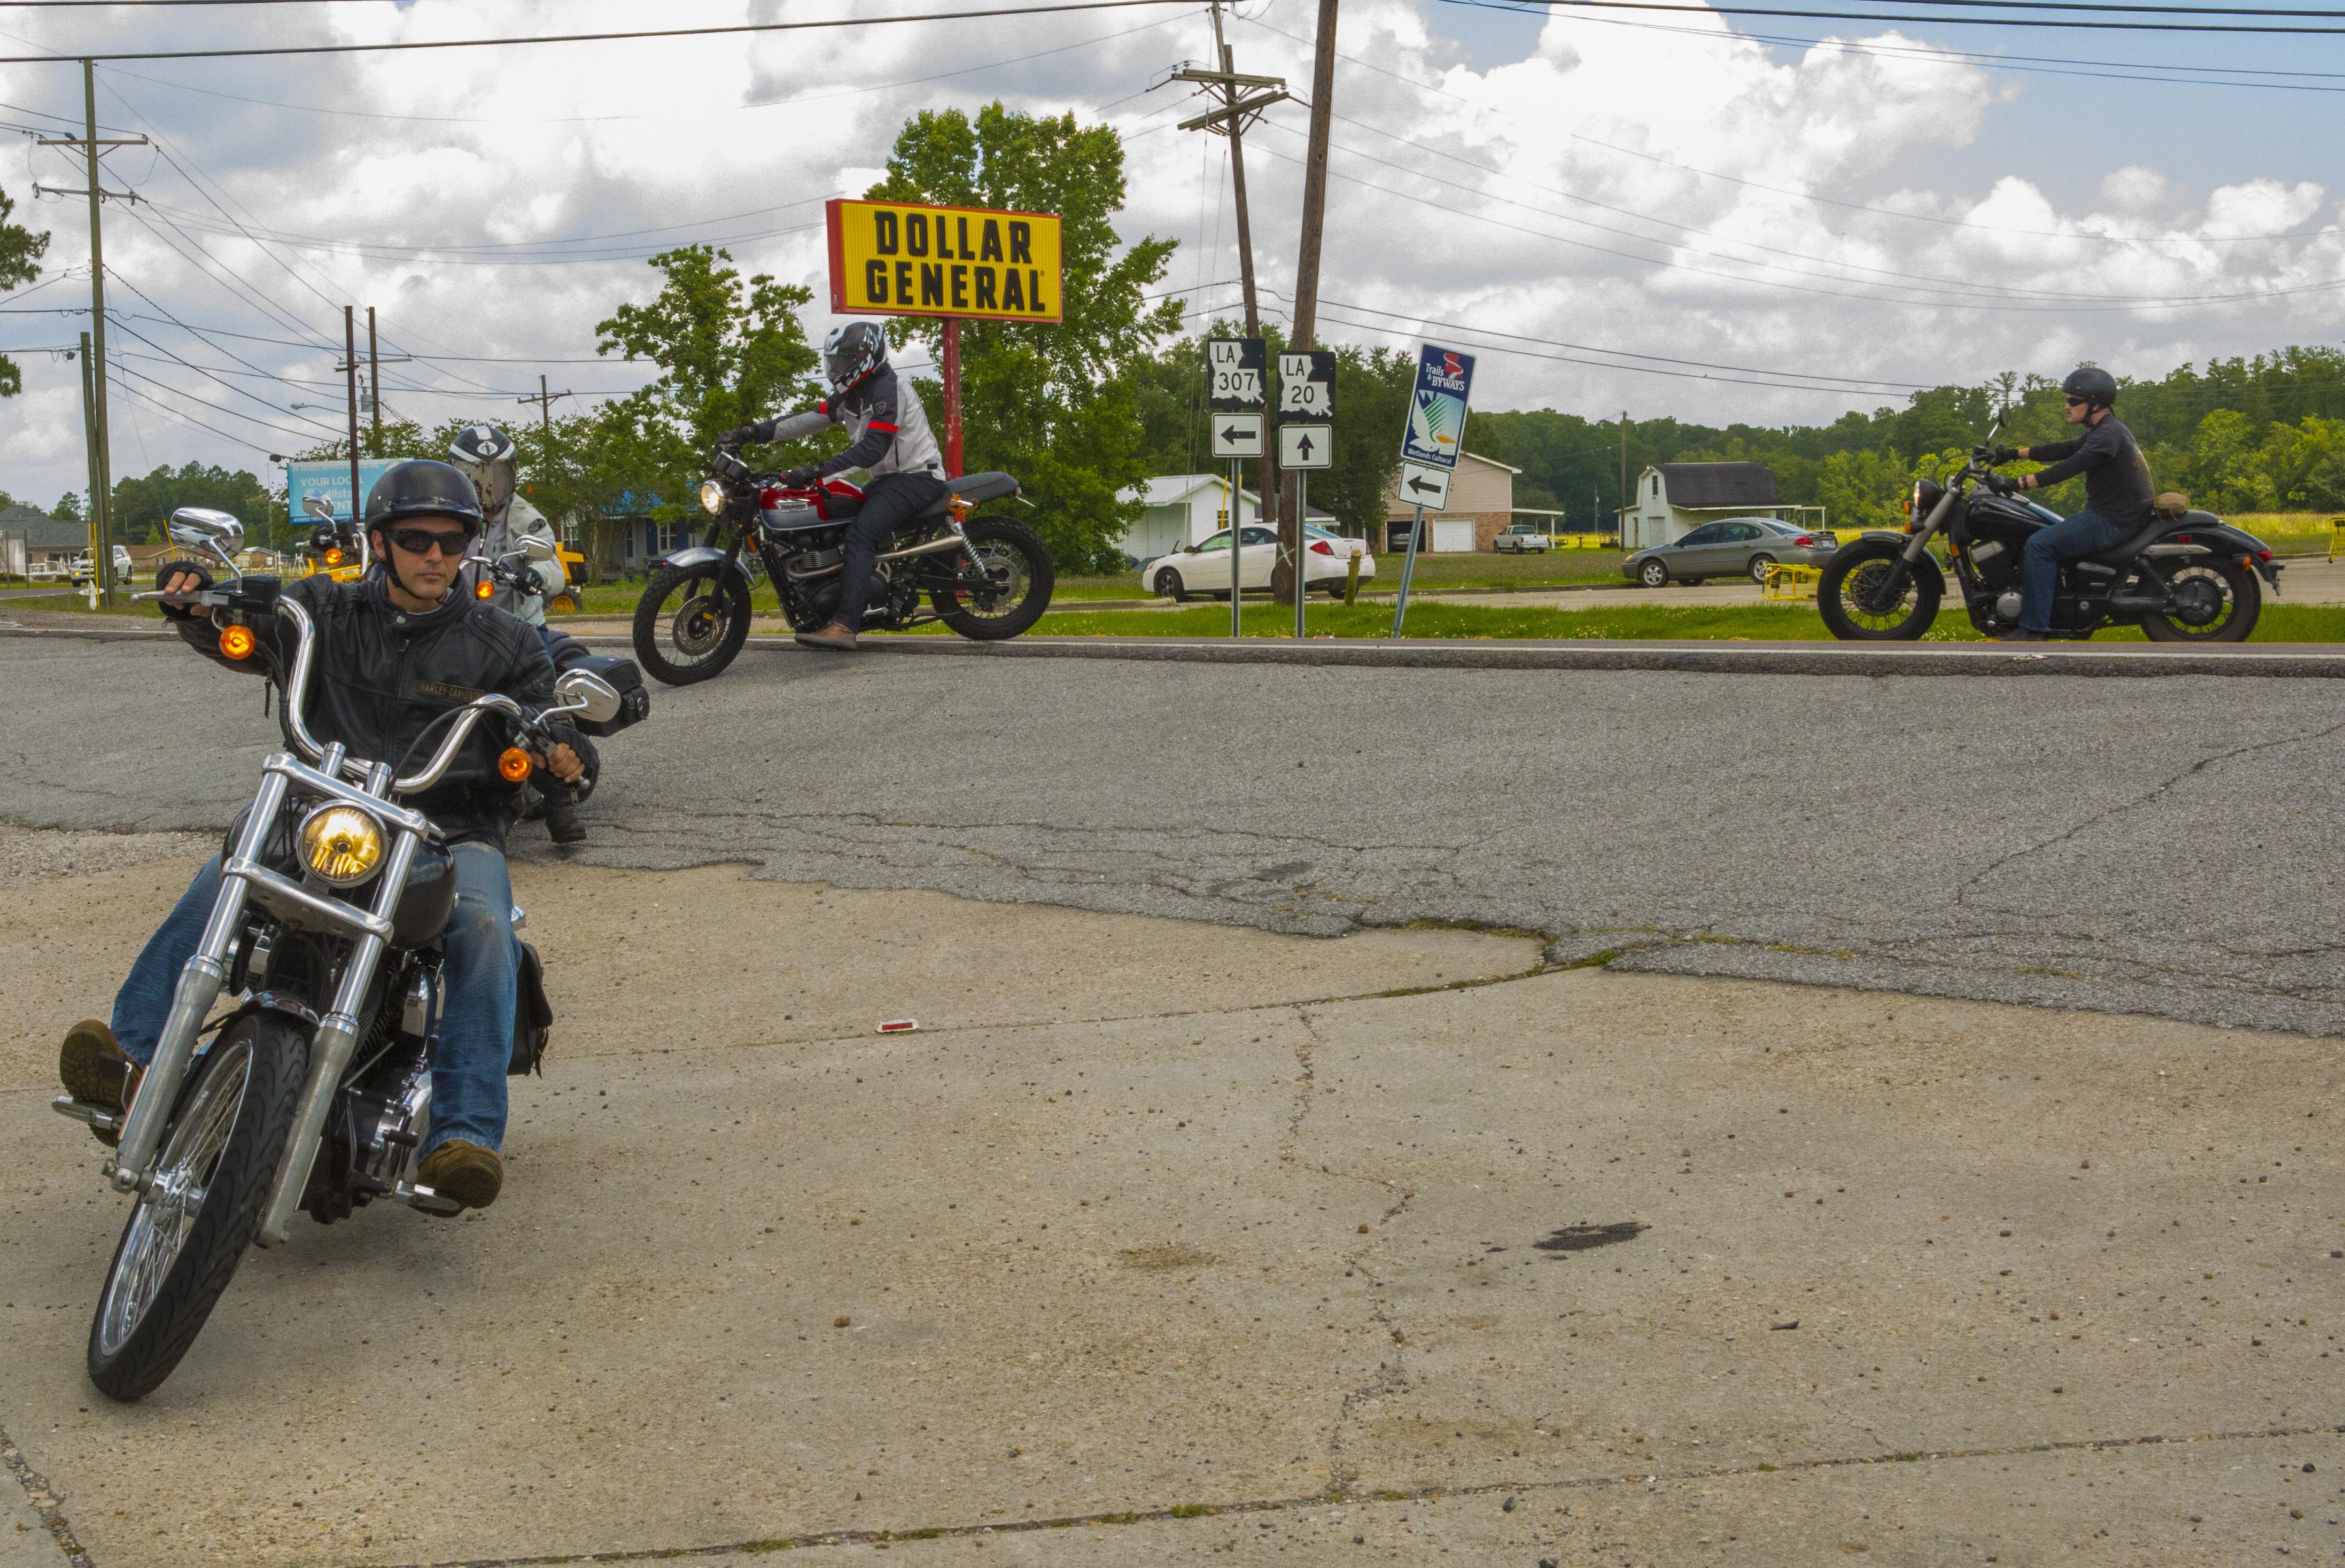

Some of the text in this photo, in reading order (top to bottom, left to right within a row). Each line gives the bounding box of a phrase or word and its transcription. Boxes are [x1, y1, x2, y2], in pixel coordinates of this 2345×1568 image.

[875, 211, 1032, 263] DOLLAR
[866, 259, 1046, 312] GENERAL
[1217, 345, 1235, 363] LA
[1286, 358, 1304, 376] LA
[1426, 363, 1444, 376] Trails
[1219, 372, 1254, 391] 307
[1432, 376, 1465, 391] BYWAYS
[1291, 385, 1314, 403] 20
[1408, 448, 1452, 464] Wetlands Cultural
[300, 476, 364, 486] YOUR LOCL
[325, 488, 363, 499] Allstae
